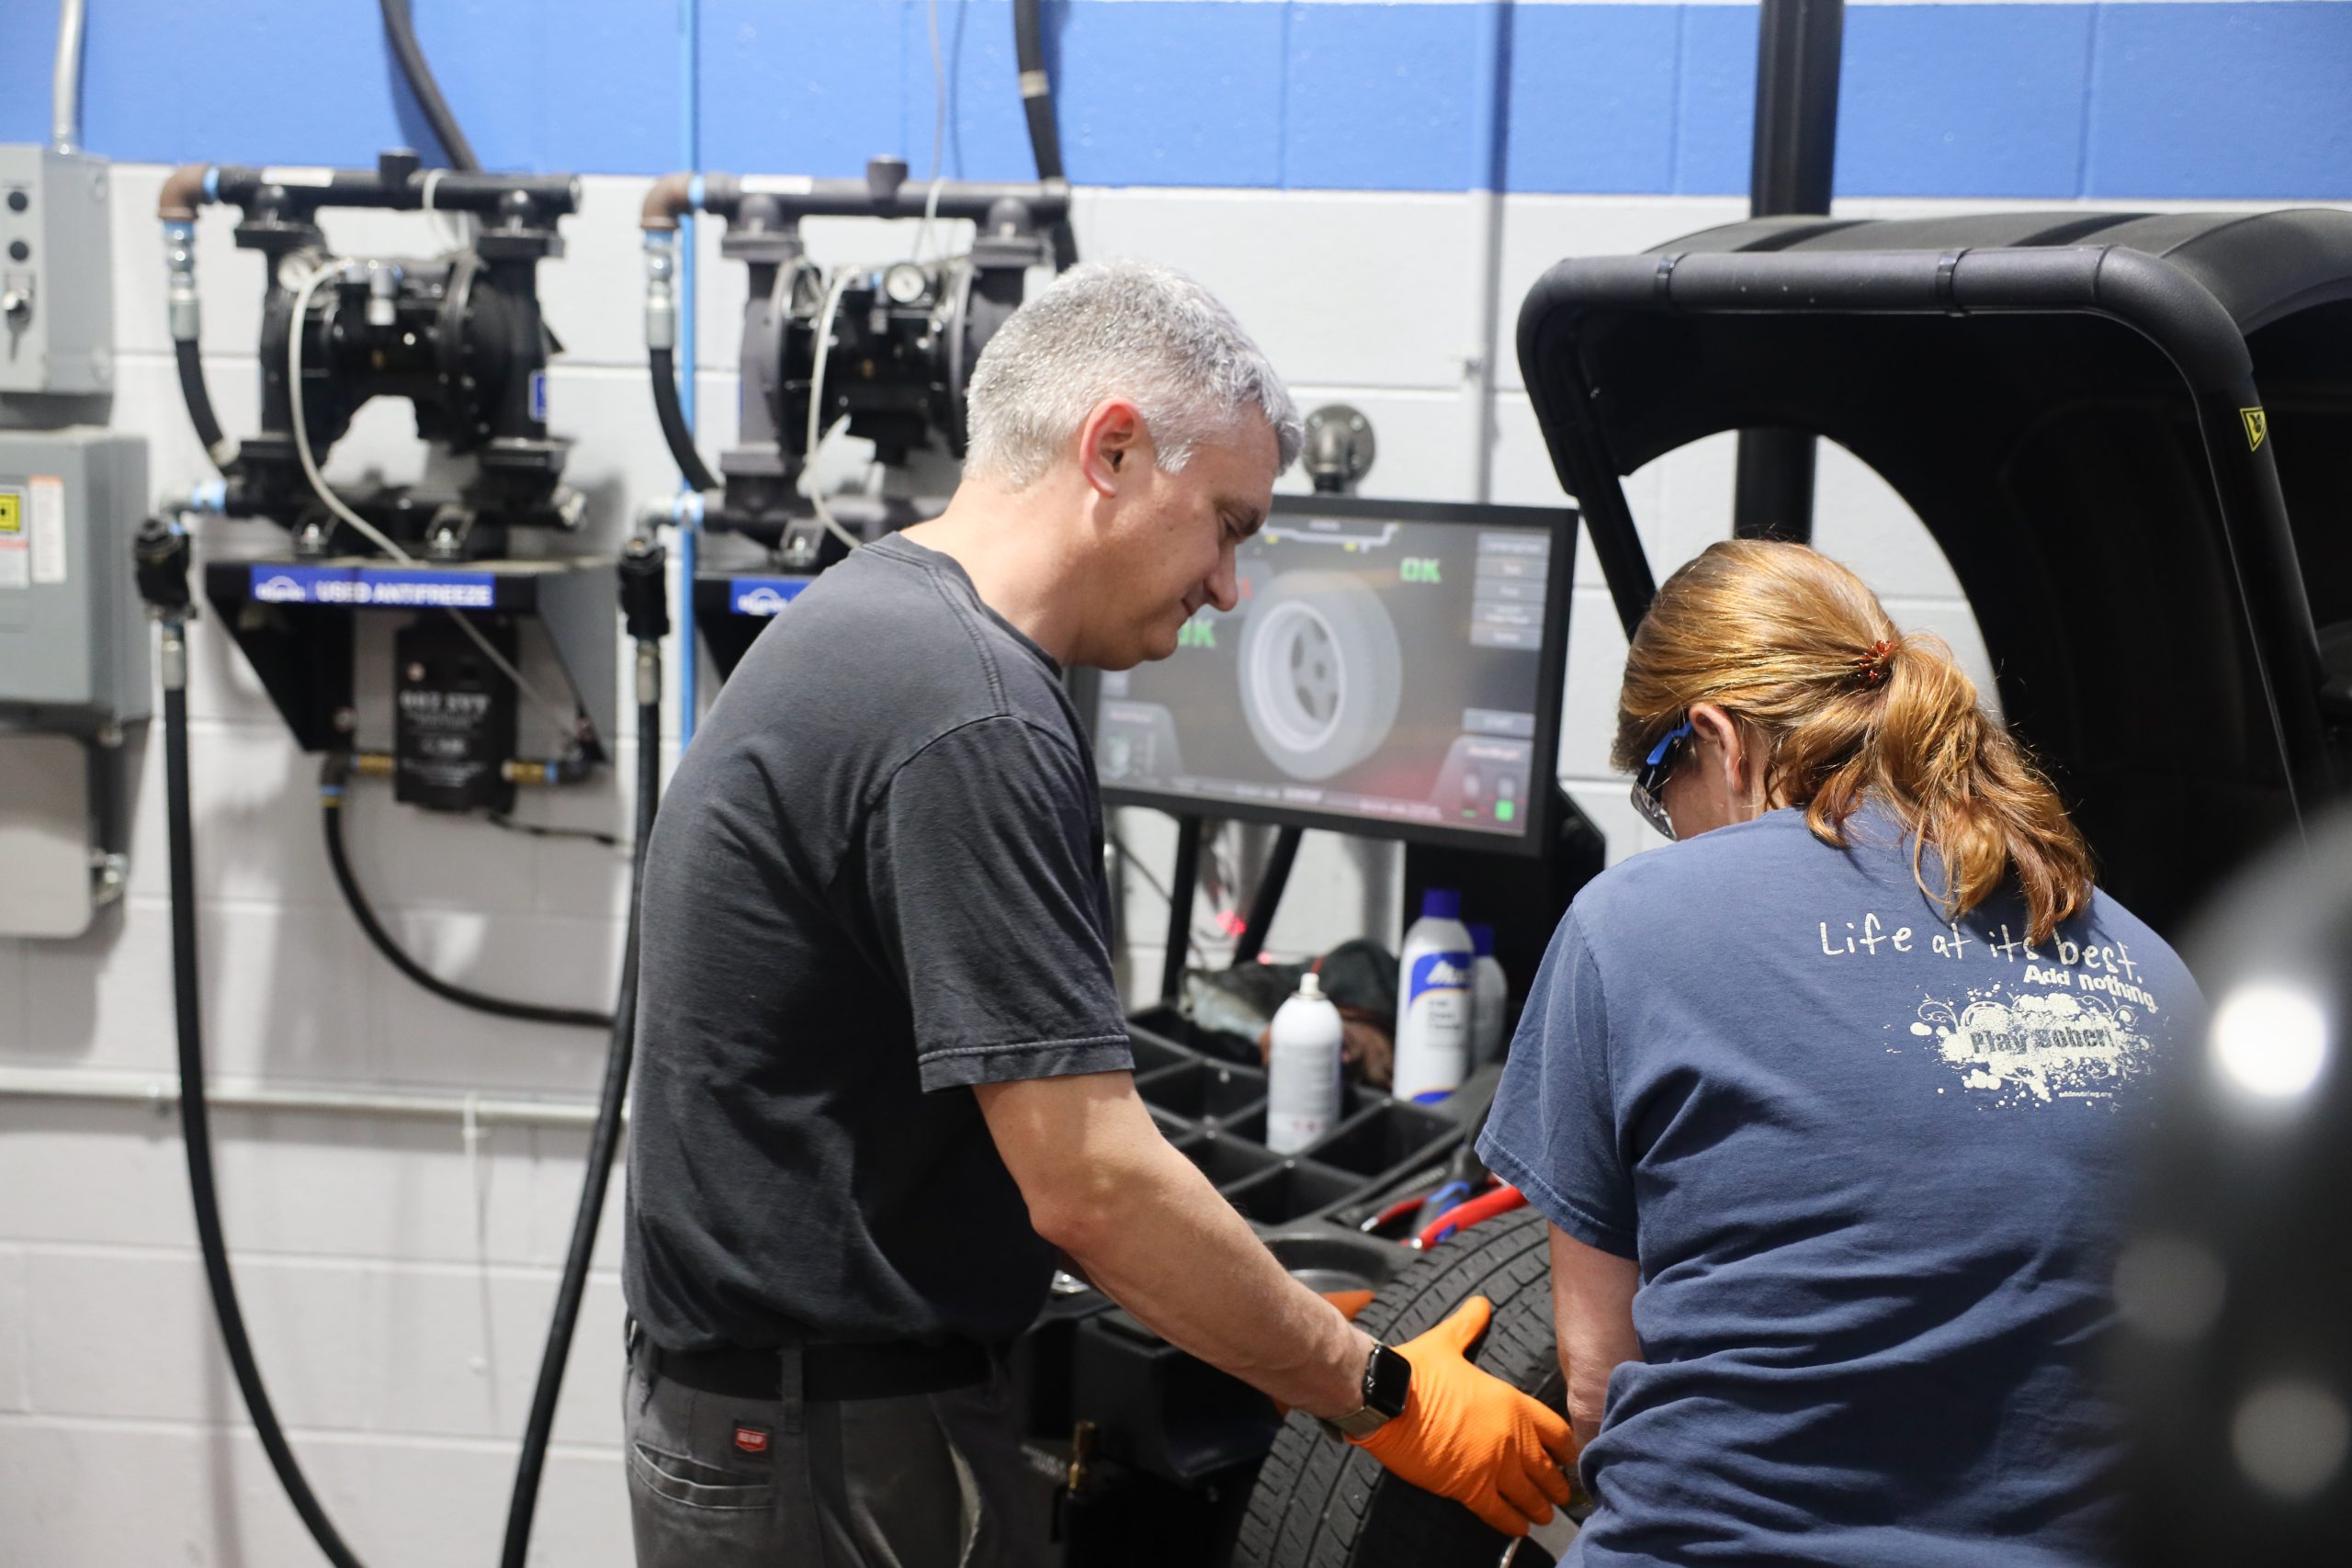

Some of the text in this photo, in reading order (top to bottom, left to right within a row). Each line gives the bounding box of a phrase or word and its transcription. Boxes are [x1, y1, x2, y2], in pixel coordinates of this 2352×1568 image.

[1400, 557, 1442, 583] OK
[315, 580, 372, 603] USED
[372, 582, 493, 606] ANTIFREEZE
[1820, 913, 1912, 955] Life
[1932, 922, 1973, 959] at
[1988, 924, 2040, 963] its
[2023, 964, 2158, 1013] Add nothing
[1971, 1030, 2028, 1055] Play
